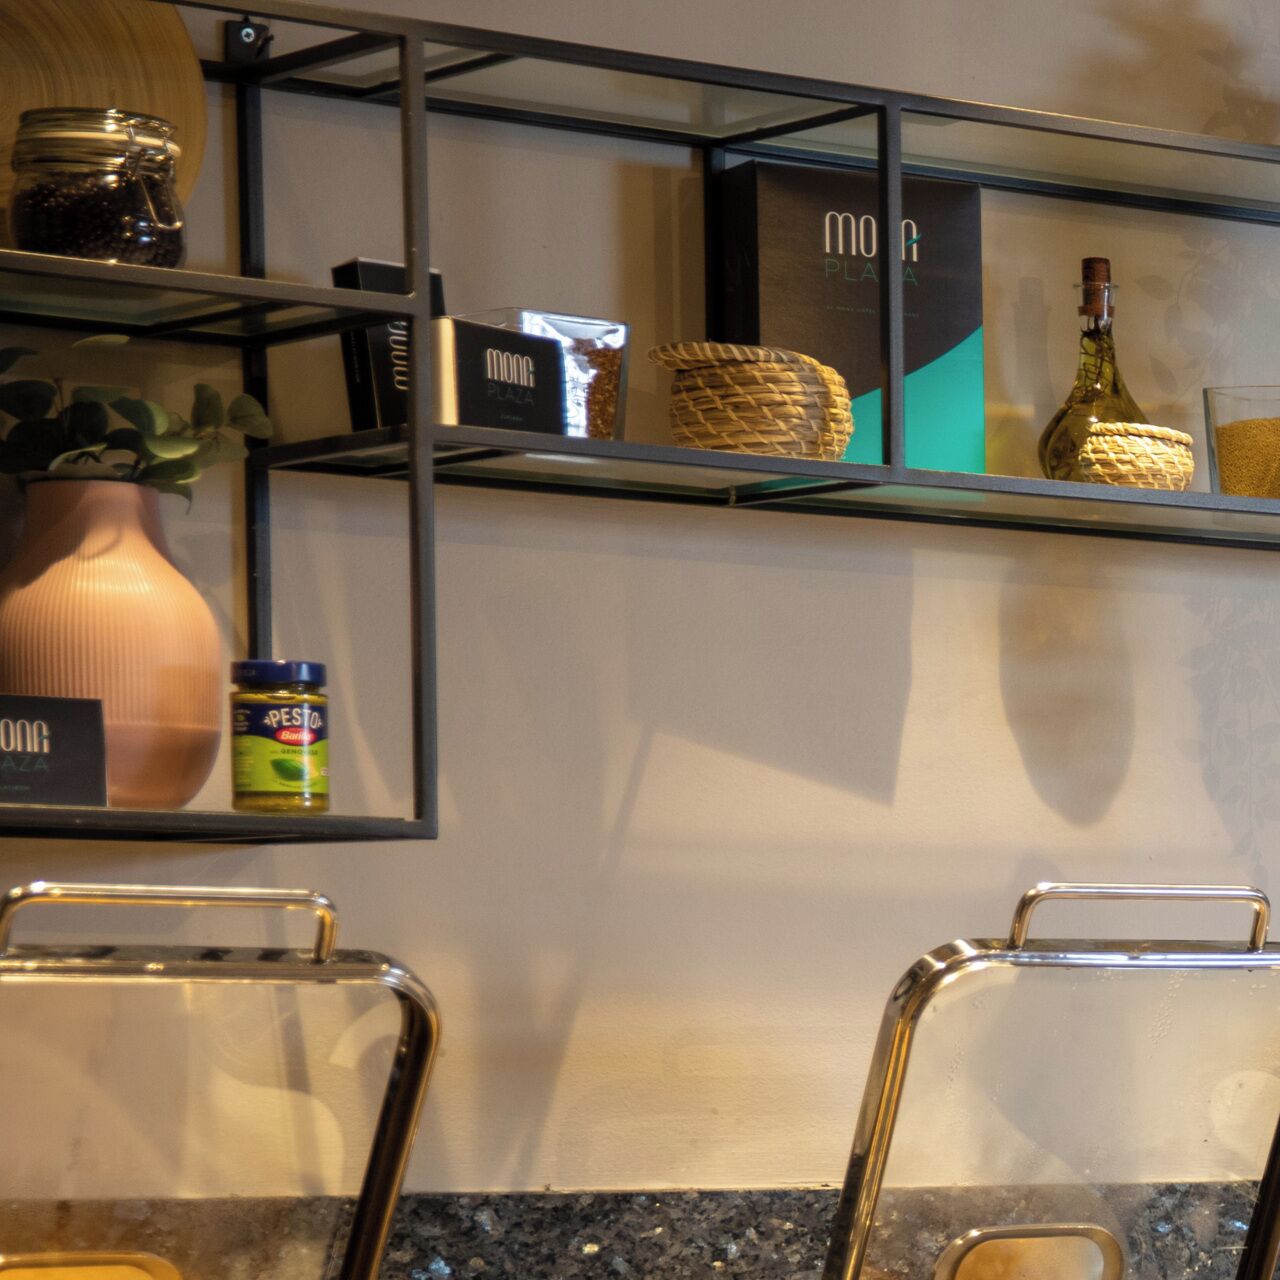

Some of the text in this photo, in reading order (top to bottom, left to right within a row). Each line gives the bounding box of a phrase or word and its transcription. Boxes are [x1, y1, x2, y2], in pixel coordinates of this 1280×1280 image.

[825, 211, 921, 262] MOA
[825, 258, 919, 286] PLAA
[487, 384, 536, 407] PLAZA
[269, 707, 318, 729] PESTO
[0, 719, 49, 753] ONA
